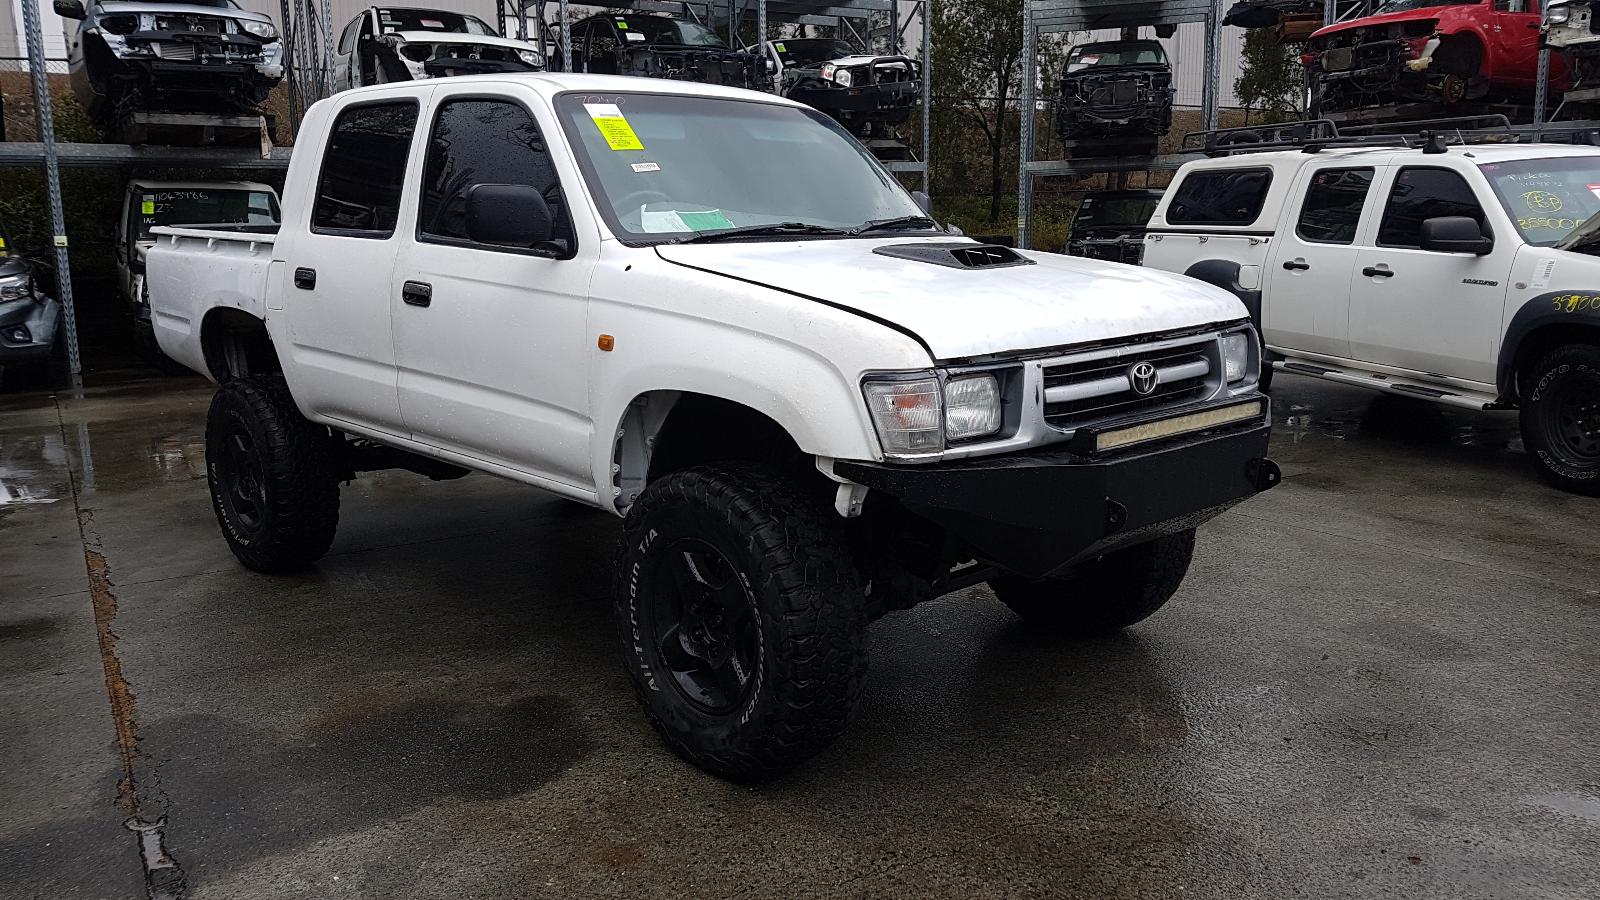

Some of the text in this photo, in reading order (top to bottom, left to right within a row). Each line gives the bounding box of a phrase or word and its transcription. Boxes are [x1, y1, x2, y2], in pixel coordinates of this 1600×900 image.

[1532, 364, 1569, 401] TOYO
[629, 528, 660, 691] All-Terrain T/A
